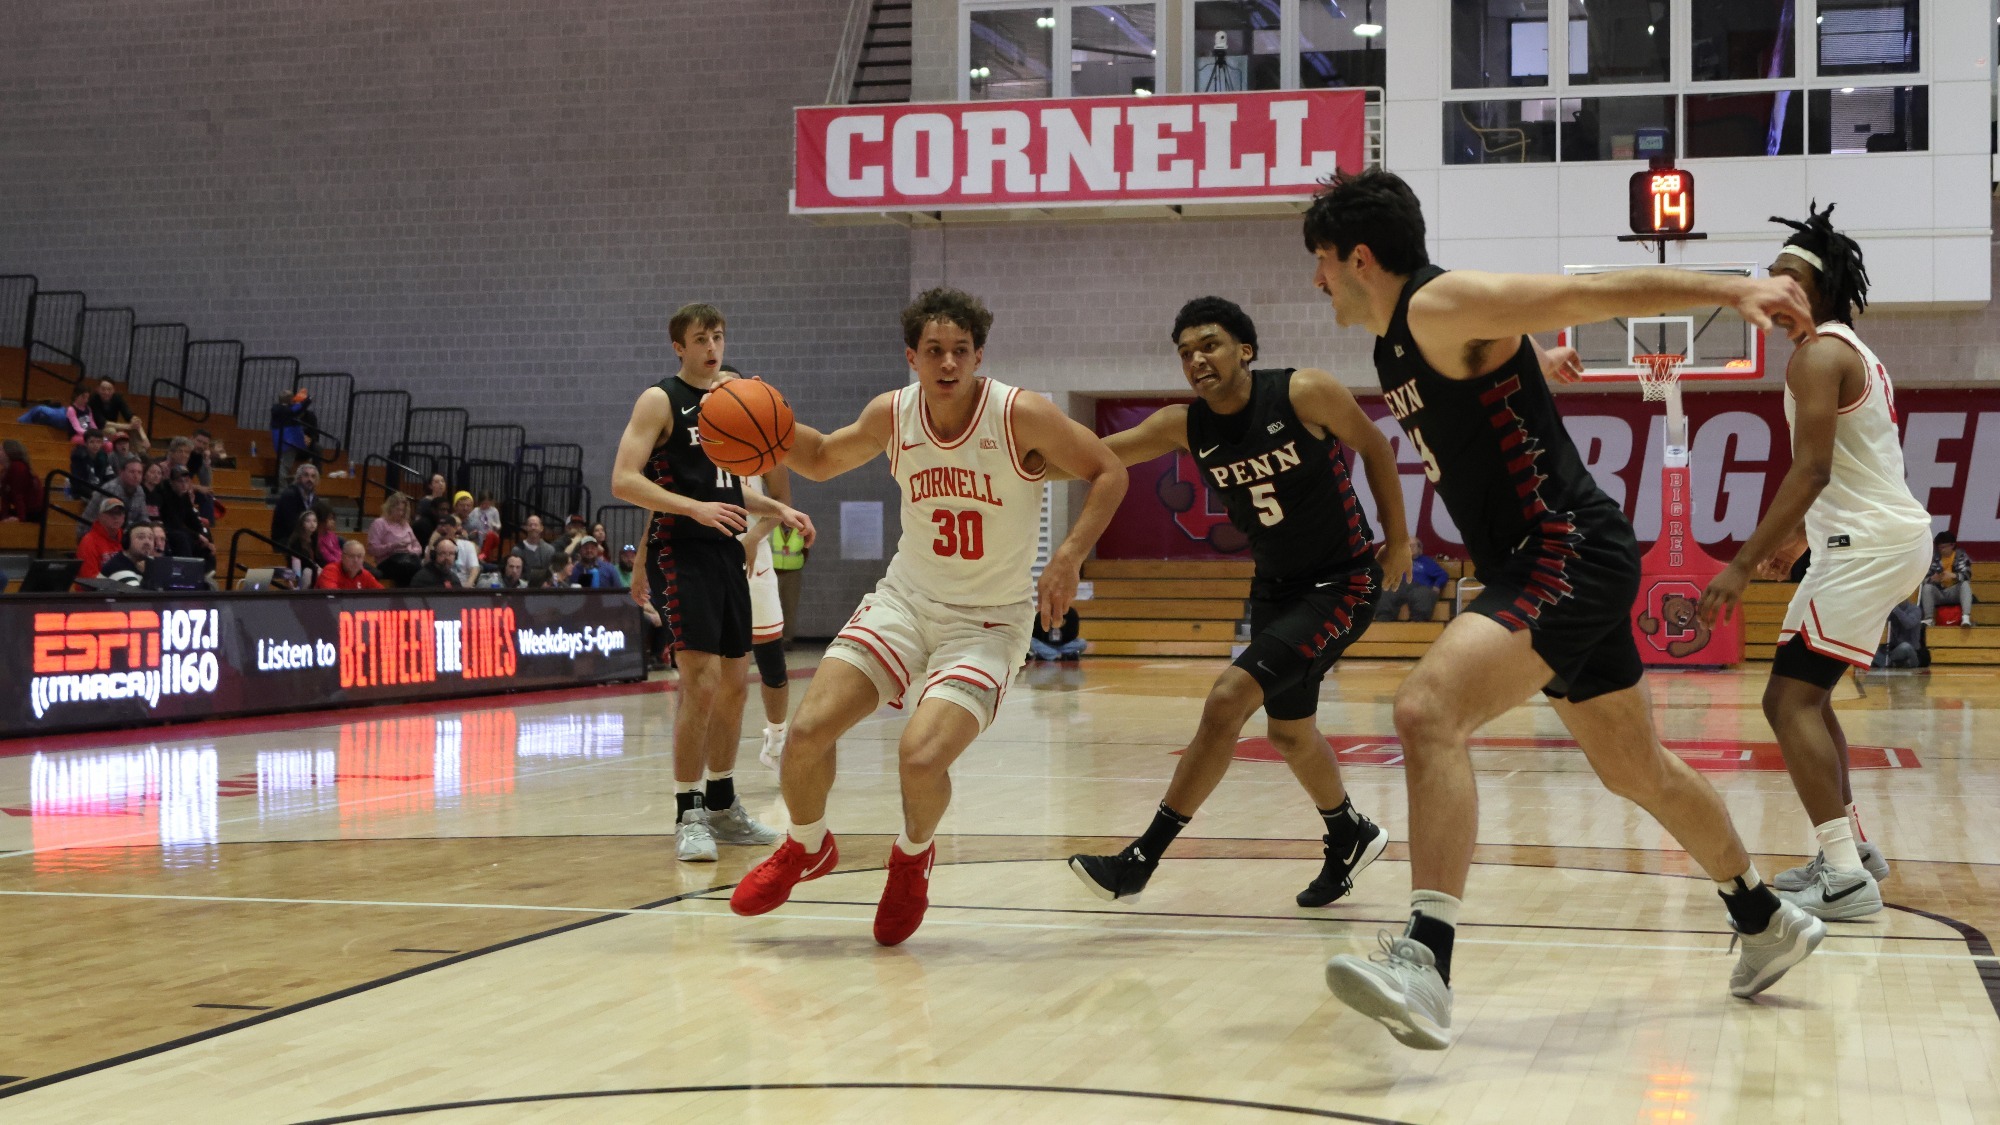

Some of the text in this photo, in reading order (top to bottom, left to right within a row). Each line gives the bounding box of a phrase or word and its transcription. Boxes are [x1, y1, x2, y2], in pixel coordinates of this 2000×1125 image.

[825, 100, 1337, 198] CORNELL
[1654, 192, 1687, 231] 14
[1384, 379, 1425, 420] ENN
[909, 466, 1003, 506] CORNELL
[1209, 440, 1301, 488] PENN
[1562, 411, 1771, 544] BIG
[1249, 483, 1284, 527] 5
[1670, 473, 1683, 516] BIG
[931, 509, 984, 560] 30
[1670, 521, 1683, 567] RED
[34, 611, 160, 672] ESPN
[162, 609, 218, 650] 107.1
[258, 607, 625, 688] Listen to BETWEEN THE LINES Weekdays 5-6pm
[161, 652, 218, 694] 1160
